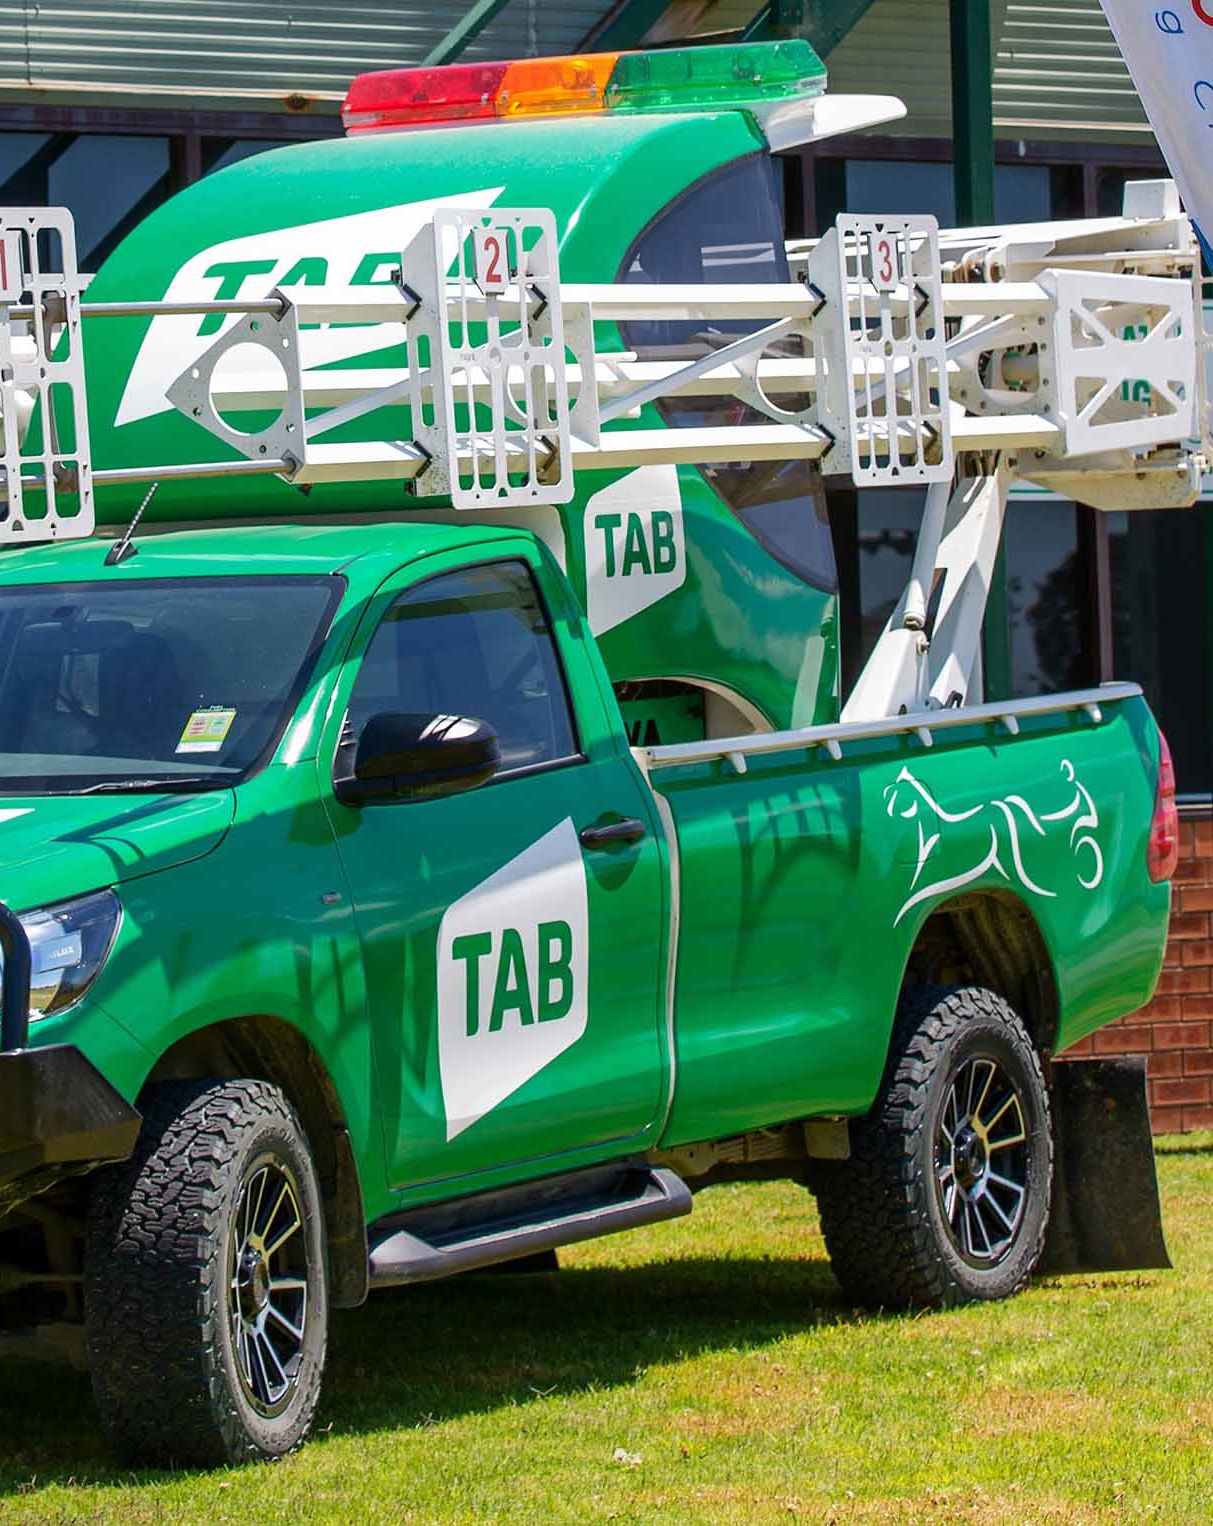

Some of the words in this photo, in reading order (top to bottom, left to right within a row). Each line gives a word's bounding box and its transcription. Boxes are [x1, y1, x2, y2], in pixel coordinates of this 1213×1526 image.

[484, 236, 502, 283] 2
[878, 240, 893, 283] 3
[594, 510, 677, 578] TAB
[451, 920, 574, 1037] TAB
